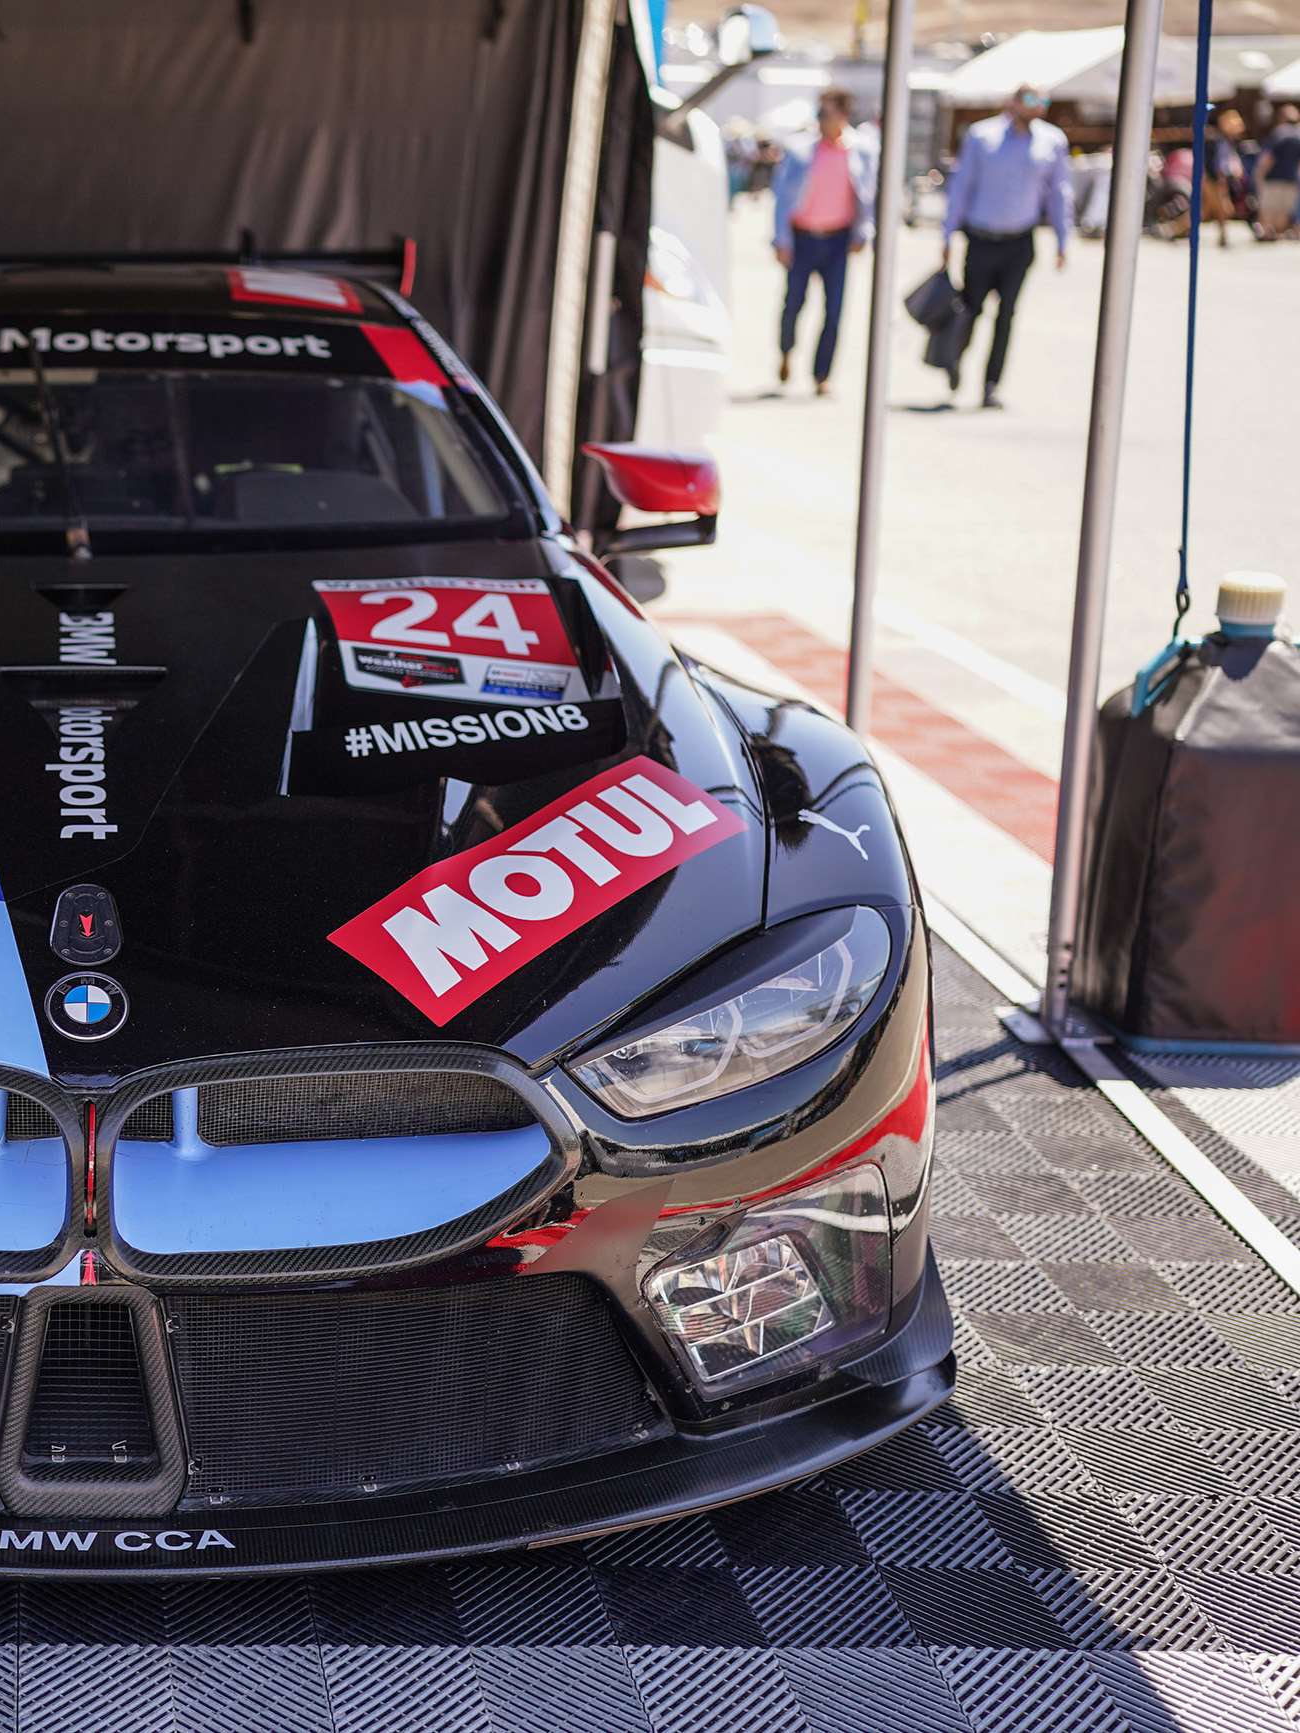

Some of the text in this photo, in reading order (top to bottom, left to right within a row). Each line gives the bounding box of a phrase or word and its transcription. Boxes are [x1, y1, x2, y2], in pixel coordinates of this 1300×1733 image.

[0, 327, 332, 359] Motorsport
[359, 589, 541, 656] 24
[344, 704, 589, 757] #MISSION8
[45, 707, 118, 840] otorsport
[381, 774, 718, 998] MOTUL
[114, 1530, 236, 1551] CCA
